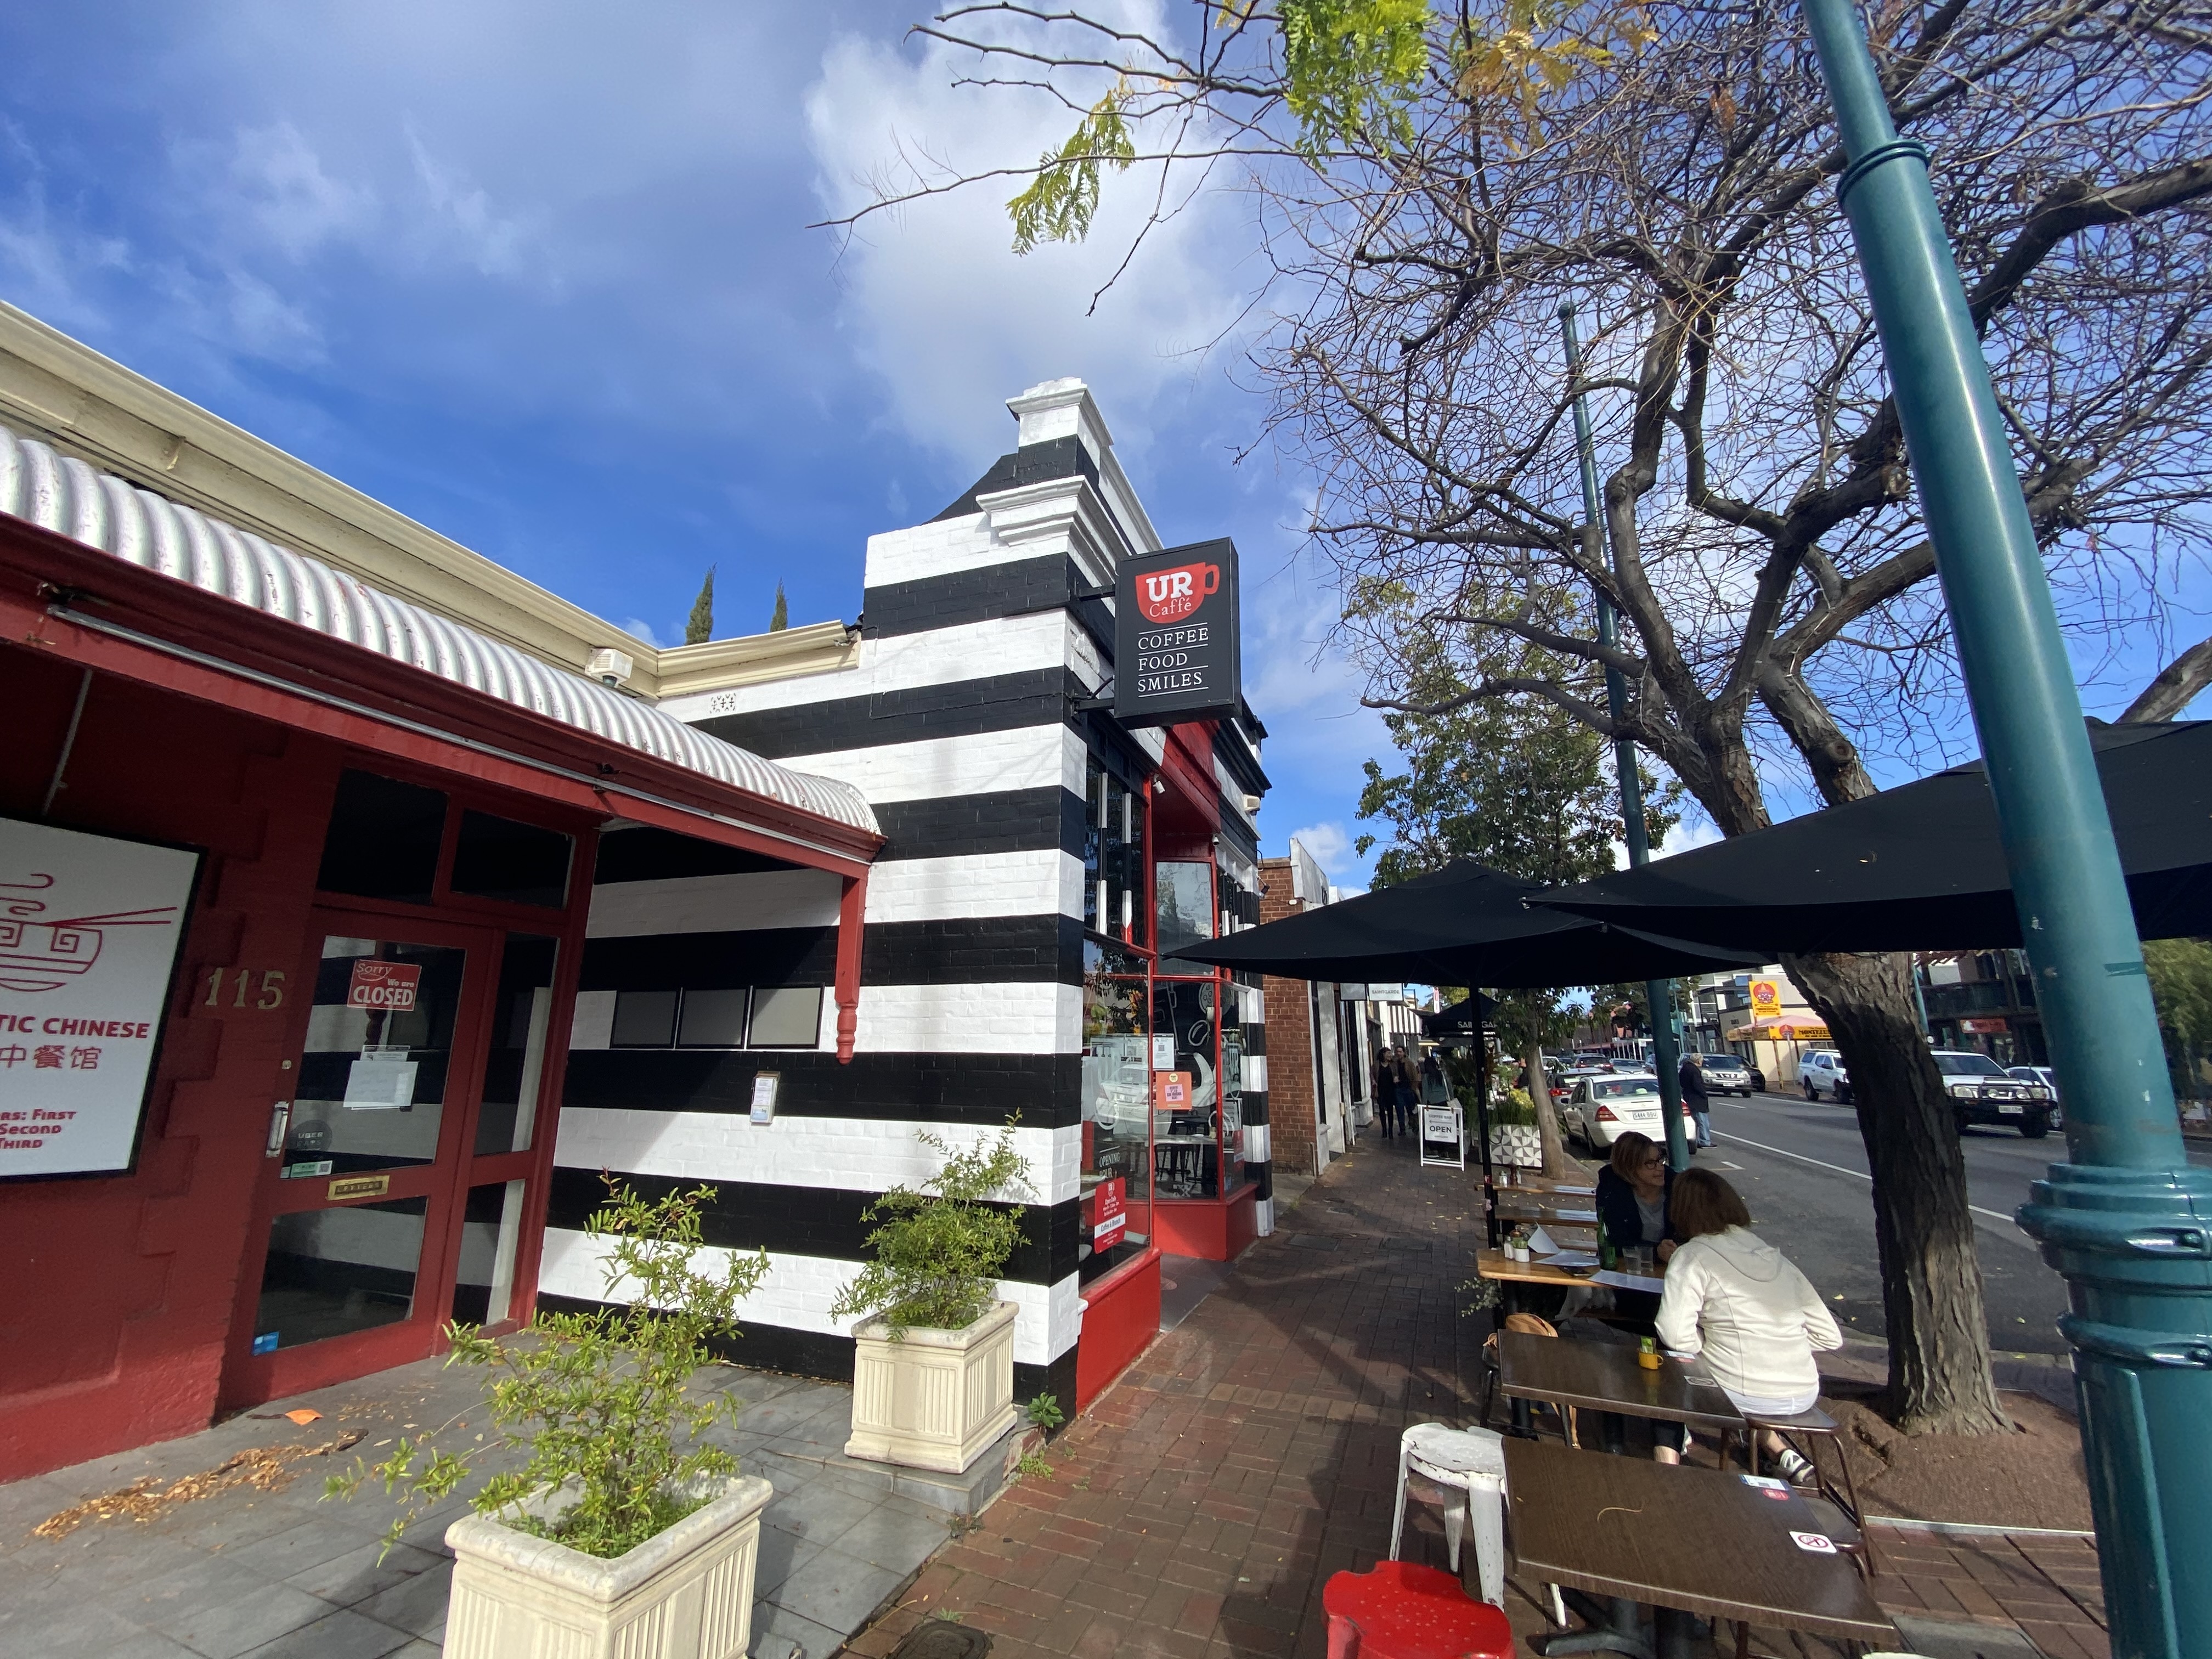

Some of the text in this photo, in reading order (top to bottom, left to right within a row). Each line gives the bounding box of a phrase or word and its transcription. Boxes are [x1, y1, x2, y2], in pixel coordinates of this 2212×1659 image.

[1146, 571, 1193, 602] UR
[1149, 597, 1192, 617] Caffé
[1138, 628, 1209, 650] COFFEE
[1138, 653, 1187, 671] FOOD
[1138, 672, 1202, 692] SMILES
[357, 963, 393, 981] Sorry
[205, 967, 285, 1009] 115
[353, 985, 413, 1006] CLOSED
[42, 1018, 150, 1038] CHINESE
[1099, 1152, 1120, 1168] OPENING
